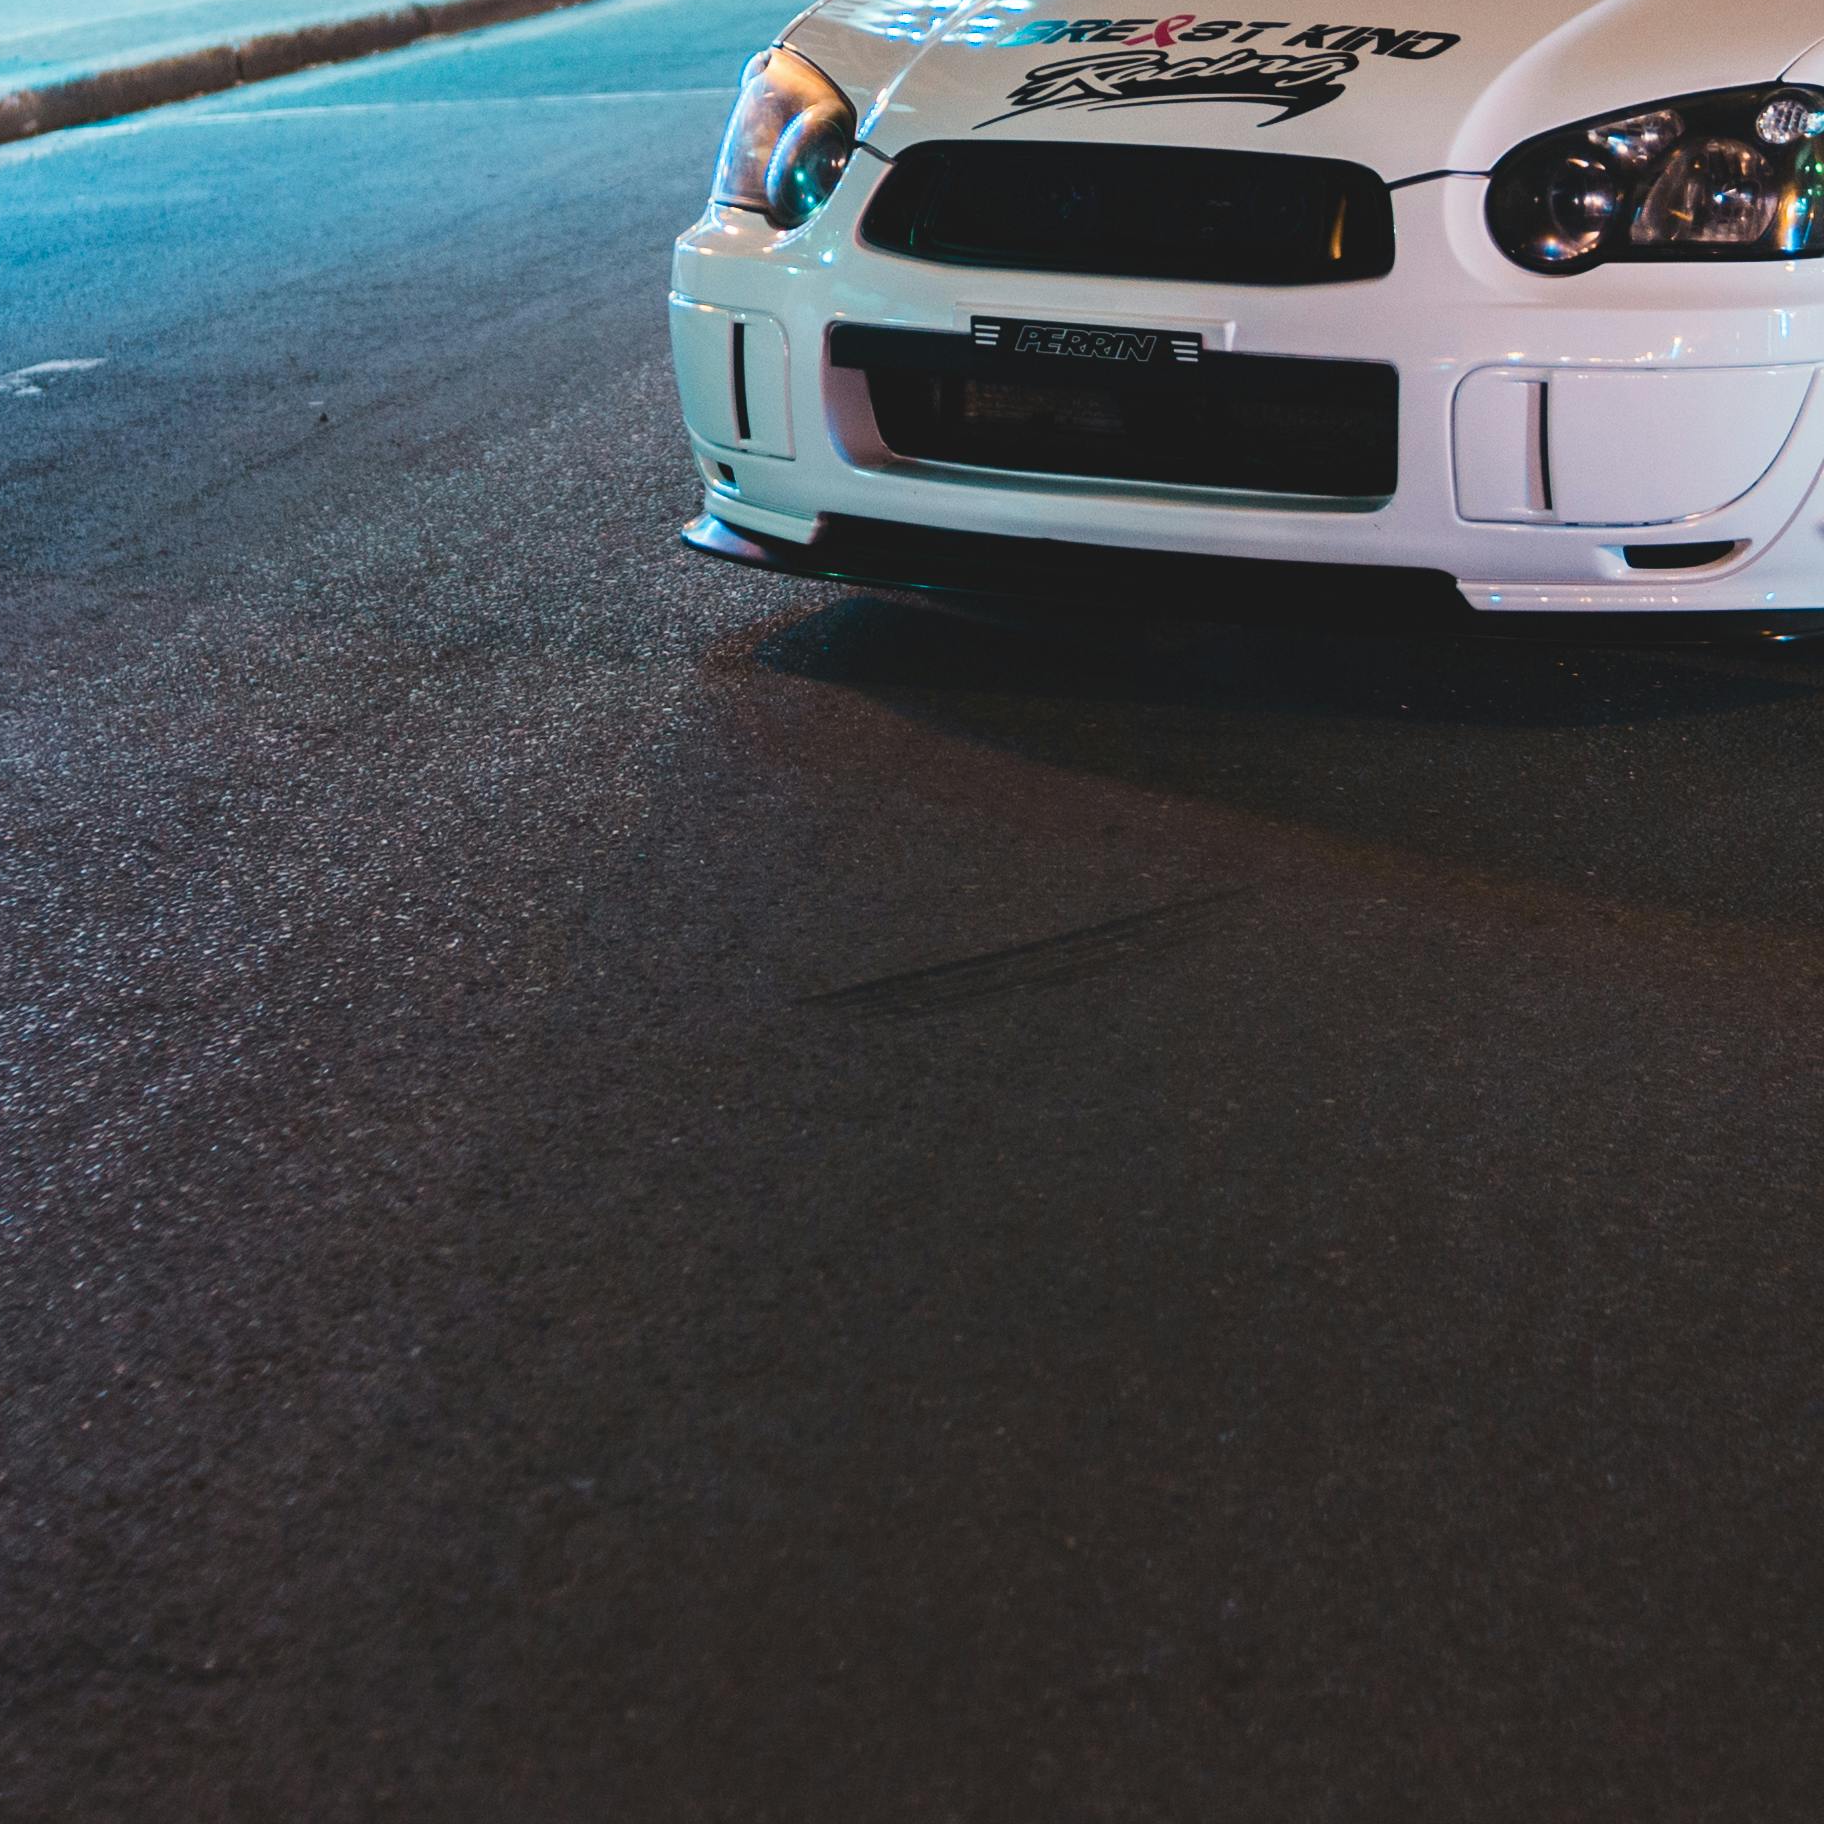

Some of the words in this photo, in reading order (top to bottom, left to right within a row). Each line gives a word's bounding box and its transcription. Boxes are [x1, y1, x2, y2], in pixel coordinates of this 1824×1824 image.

[1281, 23, 1462, 60] KIND
[1006, 48, 1360, 107] Racing
[1014, 325, 1158, 362] PERRIN
